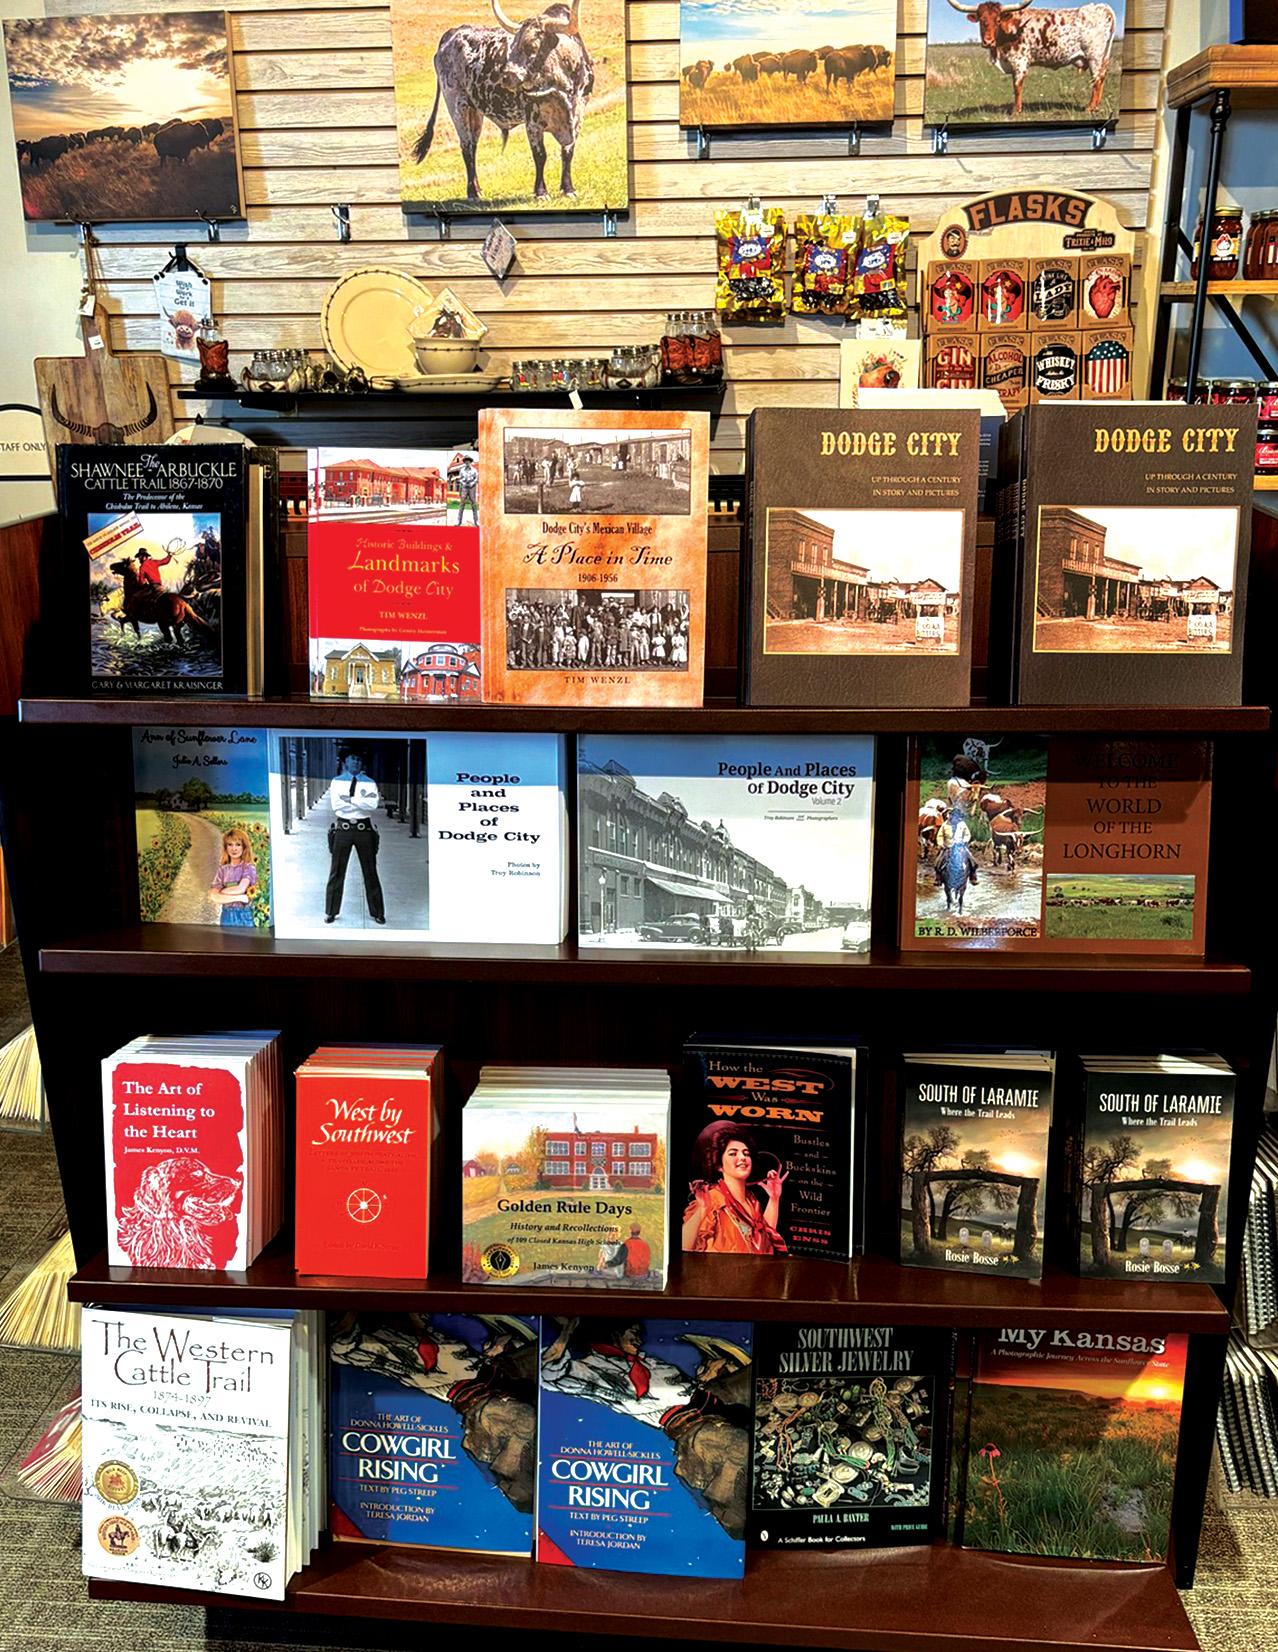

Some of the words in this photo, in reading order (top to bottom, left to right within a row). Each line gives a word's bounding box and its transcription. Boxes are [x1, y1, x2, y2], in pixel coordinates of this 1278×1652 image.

[969, 193, 1086, 231] FLASKS
[937, 348, 971, 365] GIN
[1036, 357, 1075, 371] WHISKEY
[0, 443, 20, 451] TAFF
[24, 443, 46, 451] ONLY
[821, 432, 896, 456] DODGE
[907, 432, 962, 456] CITY
[1094, 428, 1172, 453] DODGE
[1182, 428, 1239, 453] CITY
[141, 453, 160, 468] The
[84, 478, 128, 490] CATTLE
[132, 478, 166, 490] TRAIL
[169, 477, 223, 489] 1867-1870
[543, 522, 566, 534] Dodge
[569, 522, 591, 535] City's
[593, 522, 624, 534] Mexican
[627, 522, 653, 535] Village
[523, 543, 547, 565] A
[551, 541, 602, 565] Place
[607, 550, 623, 565] in
[629, 546, 673, 565] Time
[347, 550, 460, 574] Landmarks
[353, 579, 370, 593] of
[373, 579, 422, 598] Dodge
[426, 581, 453, 599] City
[379, 611, 395, 619] TIM
[398, 612, 428, 620] WENZL
[177, 729, 227, 746] Sunflower
[228, 730, 257, 744] Lane
[719, 762, 772, 780] People
[775, 765, 800, 776] And
[805, 763, 856, 777] Places
[456, 773, 520, 785] People
[1098, 776, 1117, 788] TO
[1125, 776, 1158, 788] THE
[470, 789, 506, 797] and
[768, 781, 818, 797] Dodge
[822, 781, 855, 799] City
[458, 802, 519, 812] Places
[812, 798, 835, 806] Volume
[1086, 799, 1162, 814] WORLD
[480, 817, 499, 826] of
[1093, 821, 1115, 834] OF
[1119, 821, 1153, 834] THE
[438, 831, 498, 844] Dodge
[504, 832, 541, 844] City
[1063, 843, 1181, 859] LONGHORN
[918, 928, 932, 936] BY
[935, 928, 944, 936] R.
[947, 928, 957, 936] D.
[961, 927, 1037, 937] WILBERFORCE
[709, 1060, 740, 1072] How
[744, 1062, 763, 1073] the
[122, 1081, 153, 1094] The
[158, 1082, 182, 1095] Art
[186, 1083, 203, 1095] of
[705, 1076, 824, 1095] WEST
[751, 1092, 778, 1103] Was
[919, 1083, 958, 1103] SOUTH
[962, 1086, 977, 1104] OF
[981, 1087, 1039, 1108] LARAMIE
[1100, 1093, 1139, 1112] SOUTH
[1144, 1094, 1160, 1113] OF
[1163, 1095, 1223, 1114] LARAMIE
[123, 1103, 196, 1121] Listening
[200, 1108, 215, 1117] to
[326, 1098, 377, 1121] West
[380, 1098, 402, 1128] by
[707, 1104, 824, 1123] WORN
[1122, 1116, 1144, 1125] Where
[1146, 1116, 1158, 1126] the
[1160, 1117, 1176, 1126] Trail
[1178, 1118, 1197, 1127] Leads
[124, 1126, 148, 1138] the
[152, 1126, 197, 1138] Heart
[312, 1122, 416, 1145] Southwest
[794, 1134, 830, 1147] Bustles
[804, 1151, 819, 1159] and
[786, 1161, 837, 1175] Buckskins
[799, 1190, 822, 1202] Wild
[497, 1199, 552, 1213] Golden
[556, 1201, 591, 1214] Rule
[596, 1201, 632, 1218] Days
[791, 1202, 831, 1216] Frontier
[510, 1222, 543, 1233] History
[545, 1223, 561, 1231] and
[562, 1223, 619, 1233] Recollections
[945, 1250, 970, 1263] Rosie
[973, 1252, 999, 1266] Bosse
[533, 1262, 558, 1270] James
[561, 1263, 594, 1271] Kenyon
[1125, 1260, 1150, 1273] Rosie
[1153, 1262, 1180, 1274] Bosse
[92, 1319, 148, 1355] The
[153, 1327, 274, 1365] Western
[798, 1327, 894, 1349] SOUTHWEST
[998, 1328, 1047, 1350] My
[1050, 1329, 1166, 1355] Kansas
[779, 1352, 833, 1373] SILVER
[837, 1350, 914, 1373] JEWELRY
[114, 1350, 191, 1386] Cattle
[193, 1358, 251, 1394] Trail
[90, 1398, 107, 1408] ITS
[111, 1401, 137, 1413] RISE,
[140, 1405, 197, 1420] COLLAPSE,
[200, 1412, 224, 1423] AND
[227, 1415, 272, 1428] REVIVAL
[342, 1431, 457, 1460] COWGIRL
[588, 1440, 603, 1449] THE
[358, 1459, 439, 1483] RISING
[551, 1459, 669, 1486] COWGIRL
[568, 1486, 650, 1510] RISING
[570, 1512, 589, 1520] TEXT
[591, 1513, 600, 1521] BY
[602, 1514, 617, 1522] PEG
[620, 1516, 649, 1524] STREEP
[569, 1530, 635, 1541] INTRODUCTION
[636, 1534, 648, 1542] BY
[576, 1539, 606, 1548] TERESA
[607, 1541, 640, 1550] JORDAN
